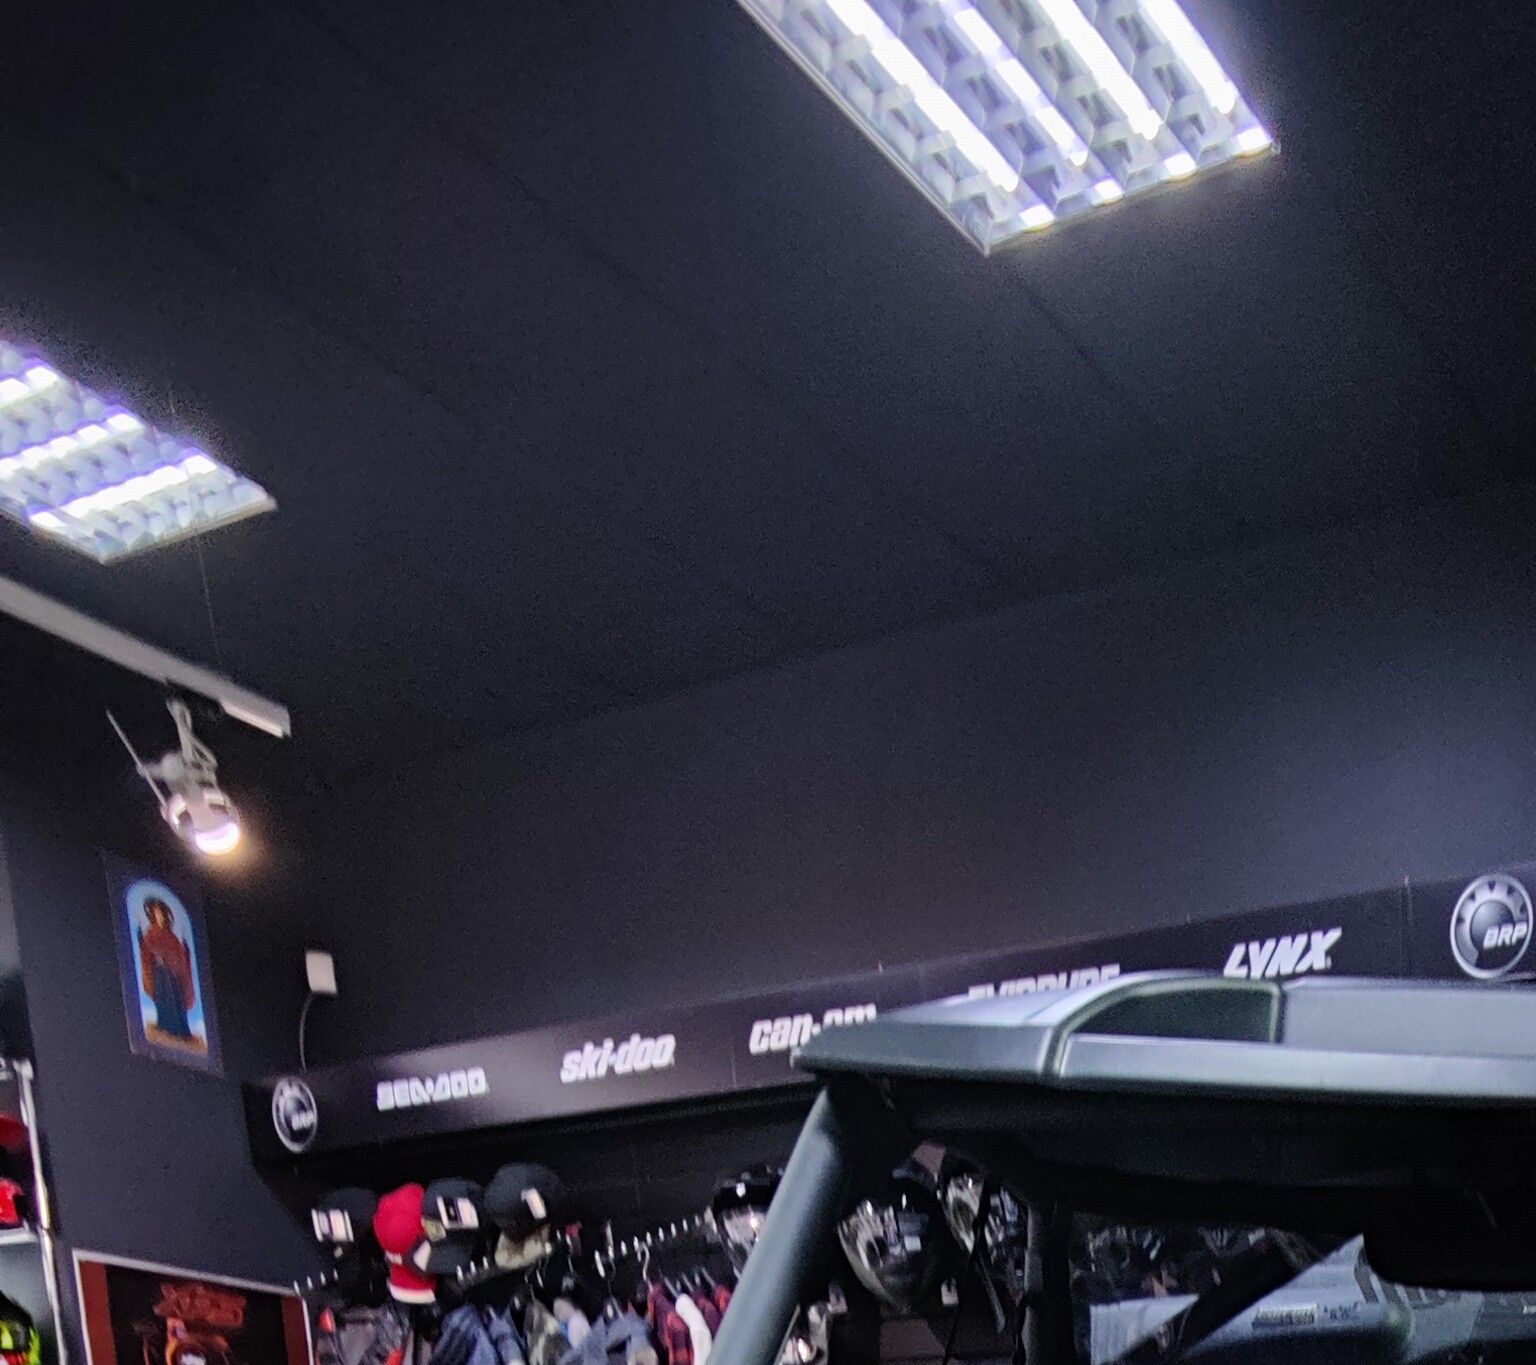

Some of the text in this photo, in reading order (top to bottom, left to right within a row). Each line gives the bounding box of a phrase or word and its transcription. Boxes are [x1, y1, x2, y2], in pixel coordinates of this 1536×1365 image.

[1223, 927, 1342, 980] LYNX
[1483, 922, 1528, 950] BRP
[561, 1032, 676, 1084] ski-doo
